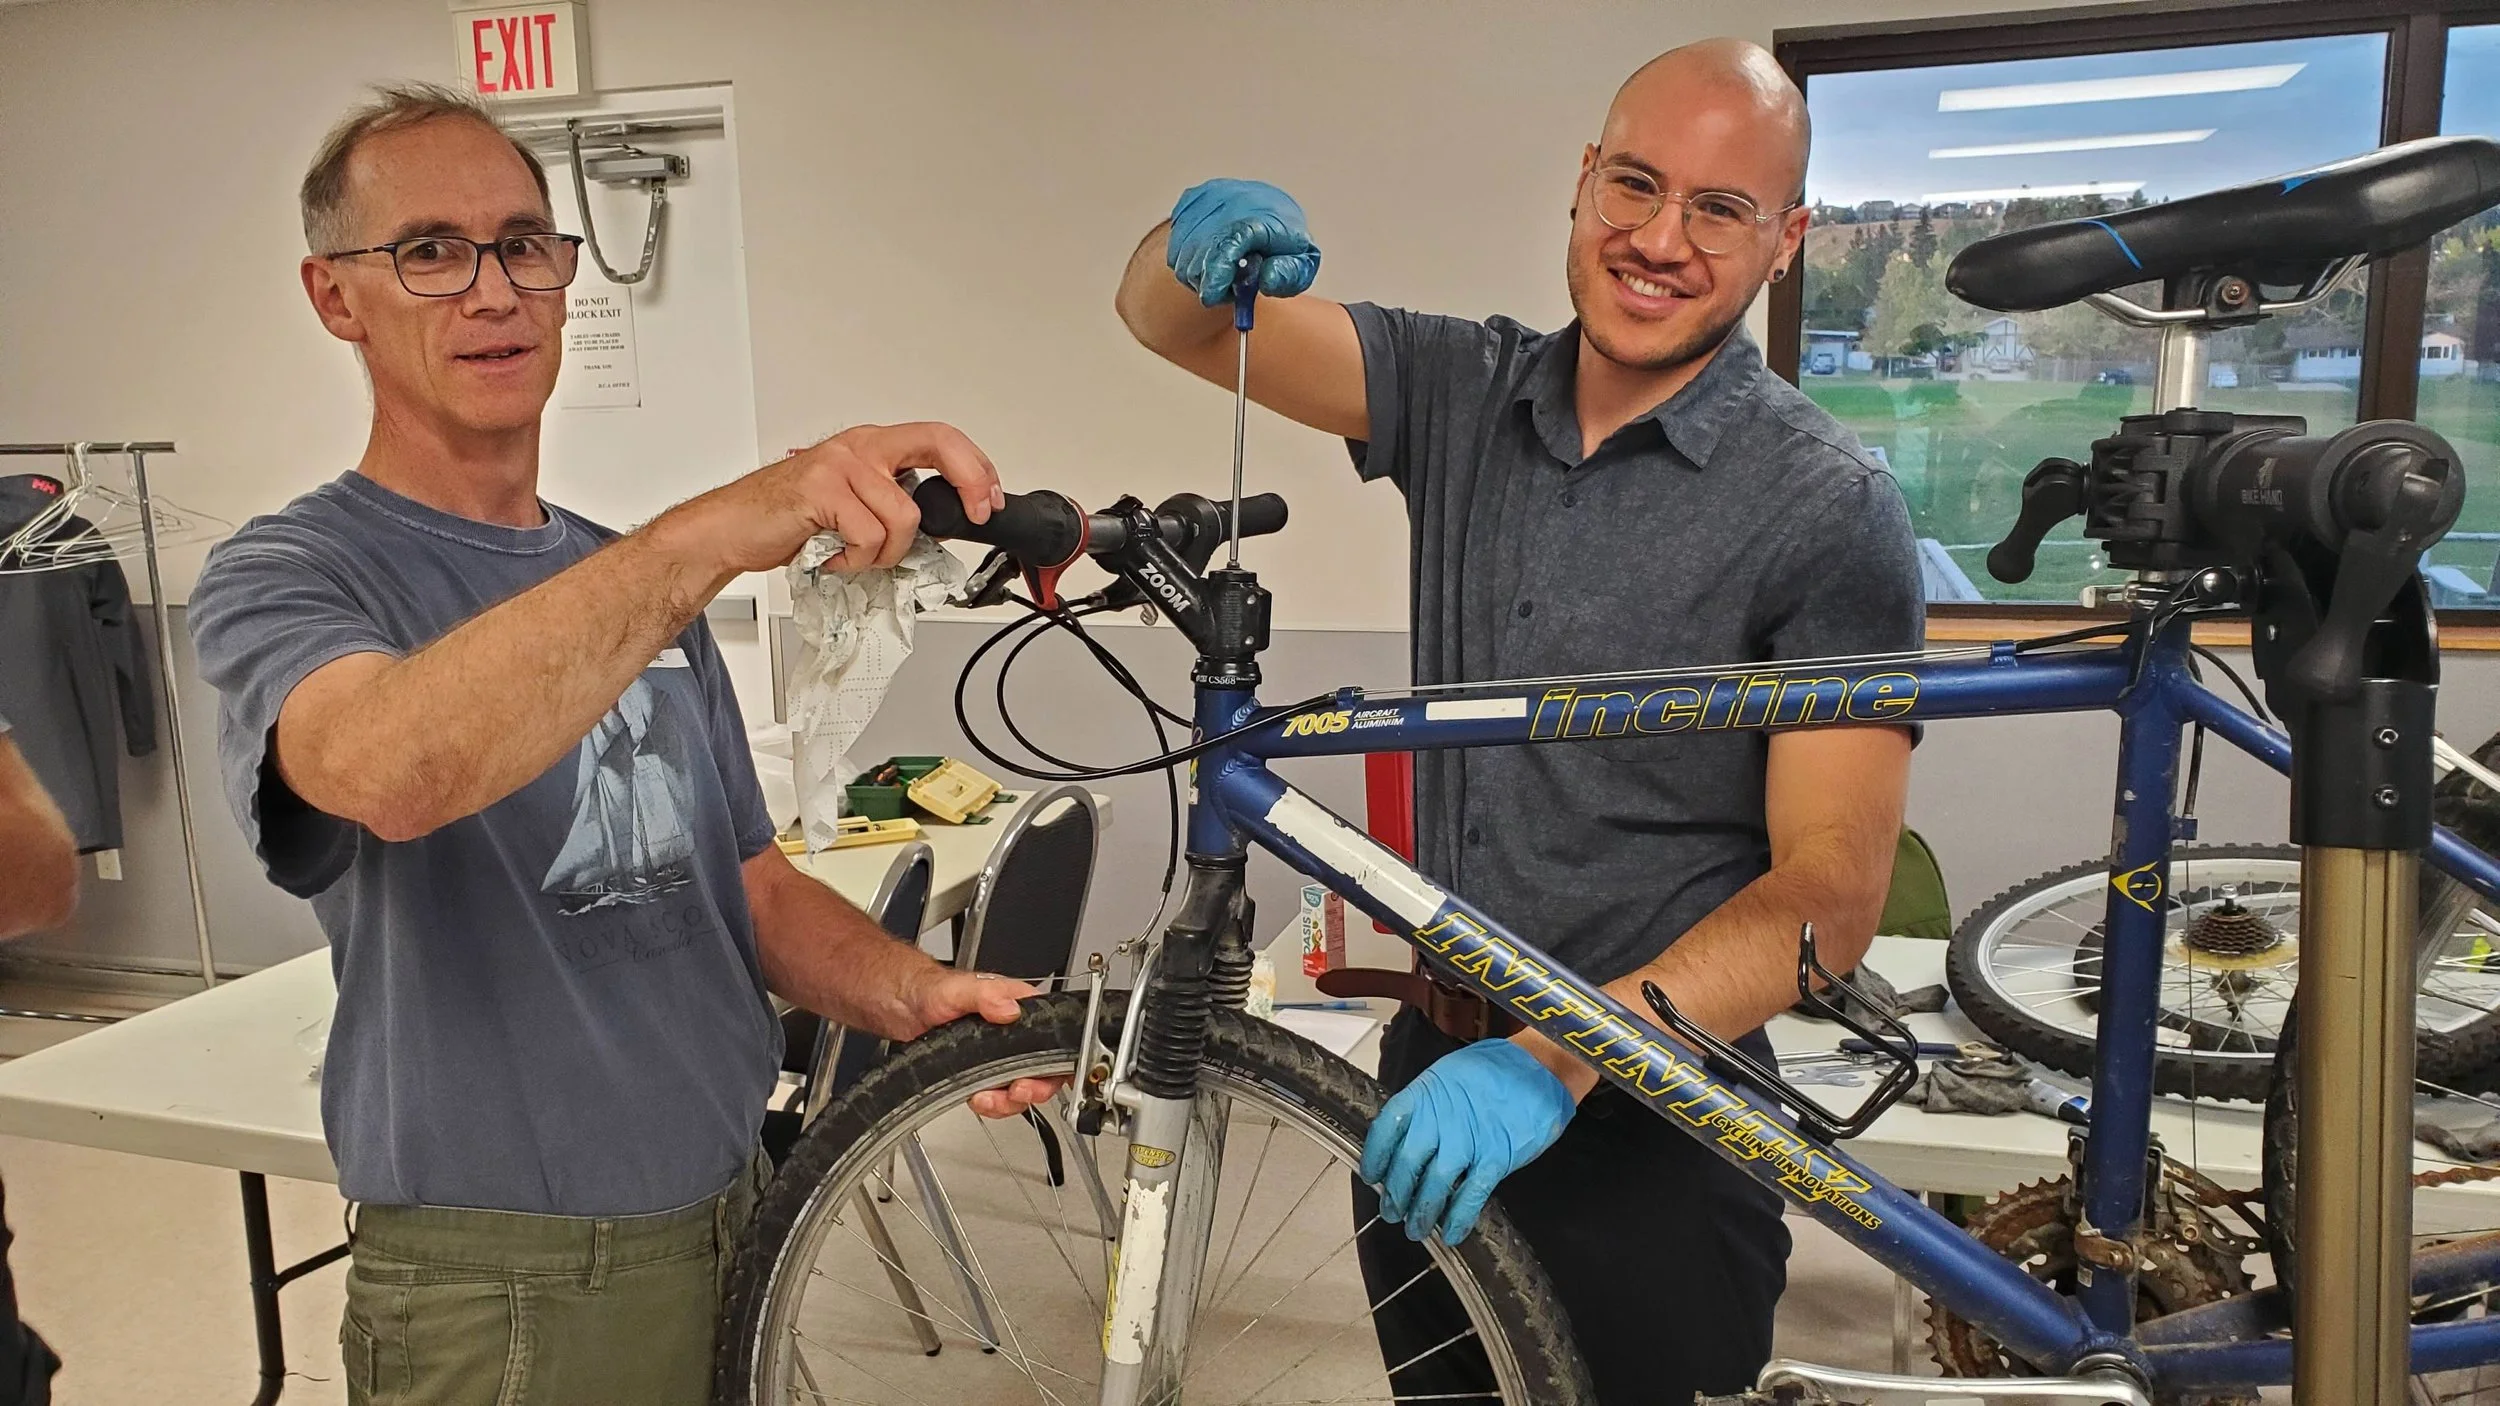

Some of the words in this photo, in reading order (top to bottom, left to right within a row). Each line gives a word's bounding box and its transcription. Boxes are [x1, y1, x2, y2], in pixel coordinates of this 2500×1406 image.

[473, 14, 556, 93] EXIT
[575, 298, 588, 307] DO
[590, 297, 610, 306] NOT
[600, 308, 621, 318] EXIT
[1138, 561, 1191, 613] ZOOM
[1281, 710, 1353, 737] 7005
[1351, 718, 1404, 729] ALUMINUM
[1354, 708, 1399, 719] AIRCRAFT
[1528, 672, 1921, 741] incline
[1410, 911, 1873, 1203] INFINITY
[1711, 1114, 1778, 1161] CYCLING
[1774, 1156, 1883, 1230] INNOVATIONS
